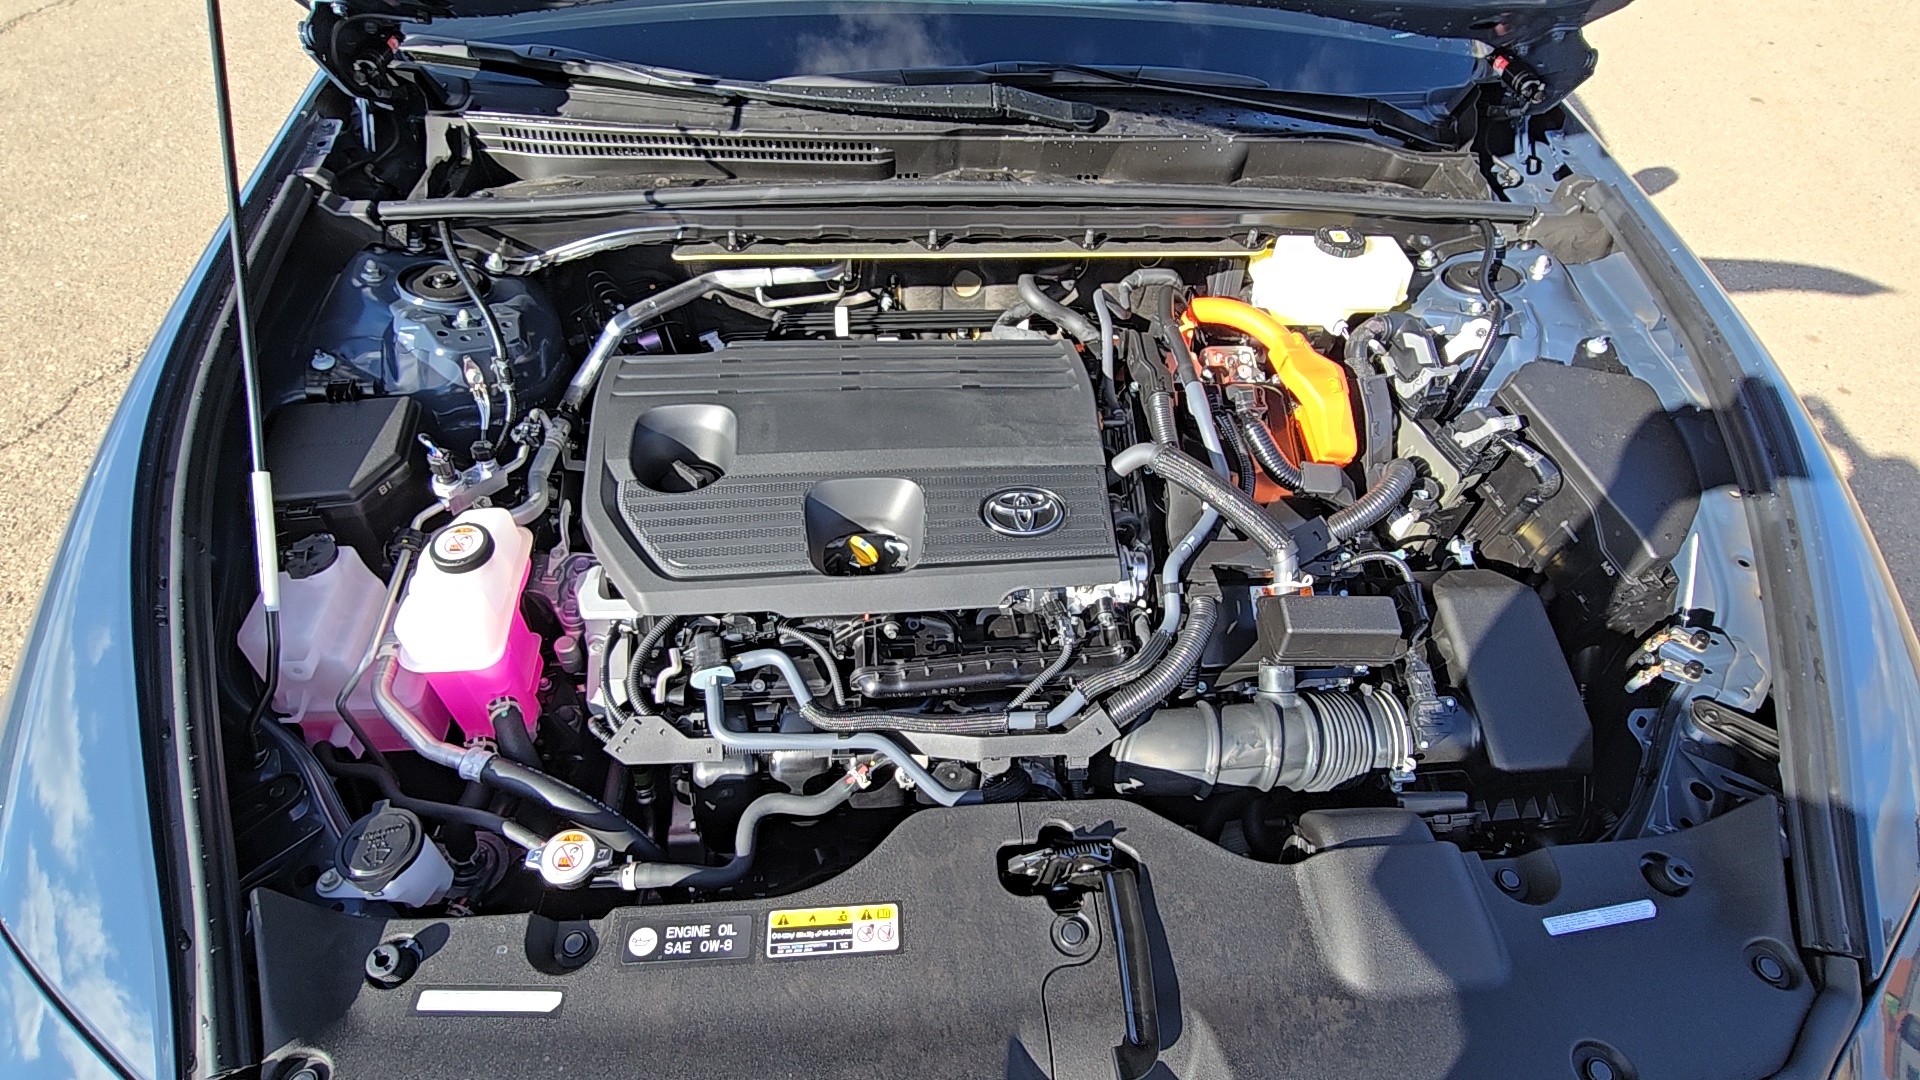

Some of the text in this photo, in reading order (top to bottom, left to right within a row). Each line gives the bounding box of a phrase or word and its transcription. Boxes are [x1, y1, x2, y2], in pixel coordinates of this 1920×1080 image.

[378, 480, 393, 496] B1
[665, 923, 738, 939] ENGINE OIL
[664, 940, 693, 955] SAE
